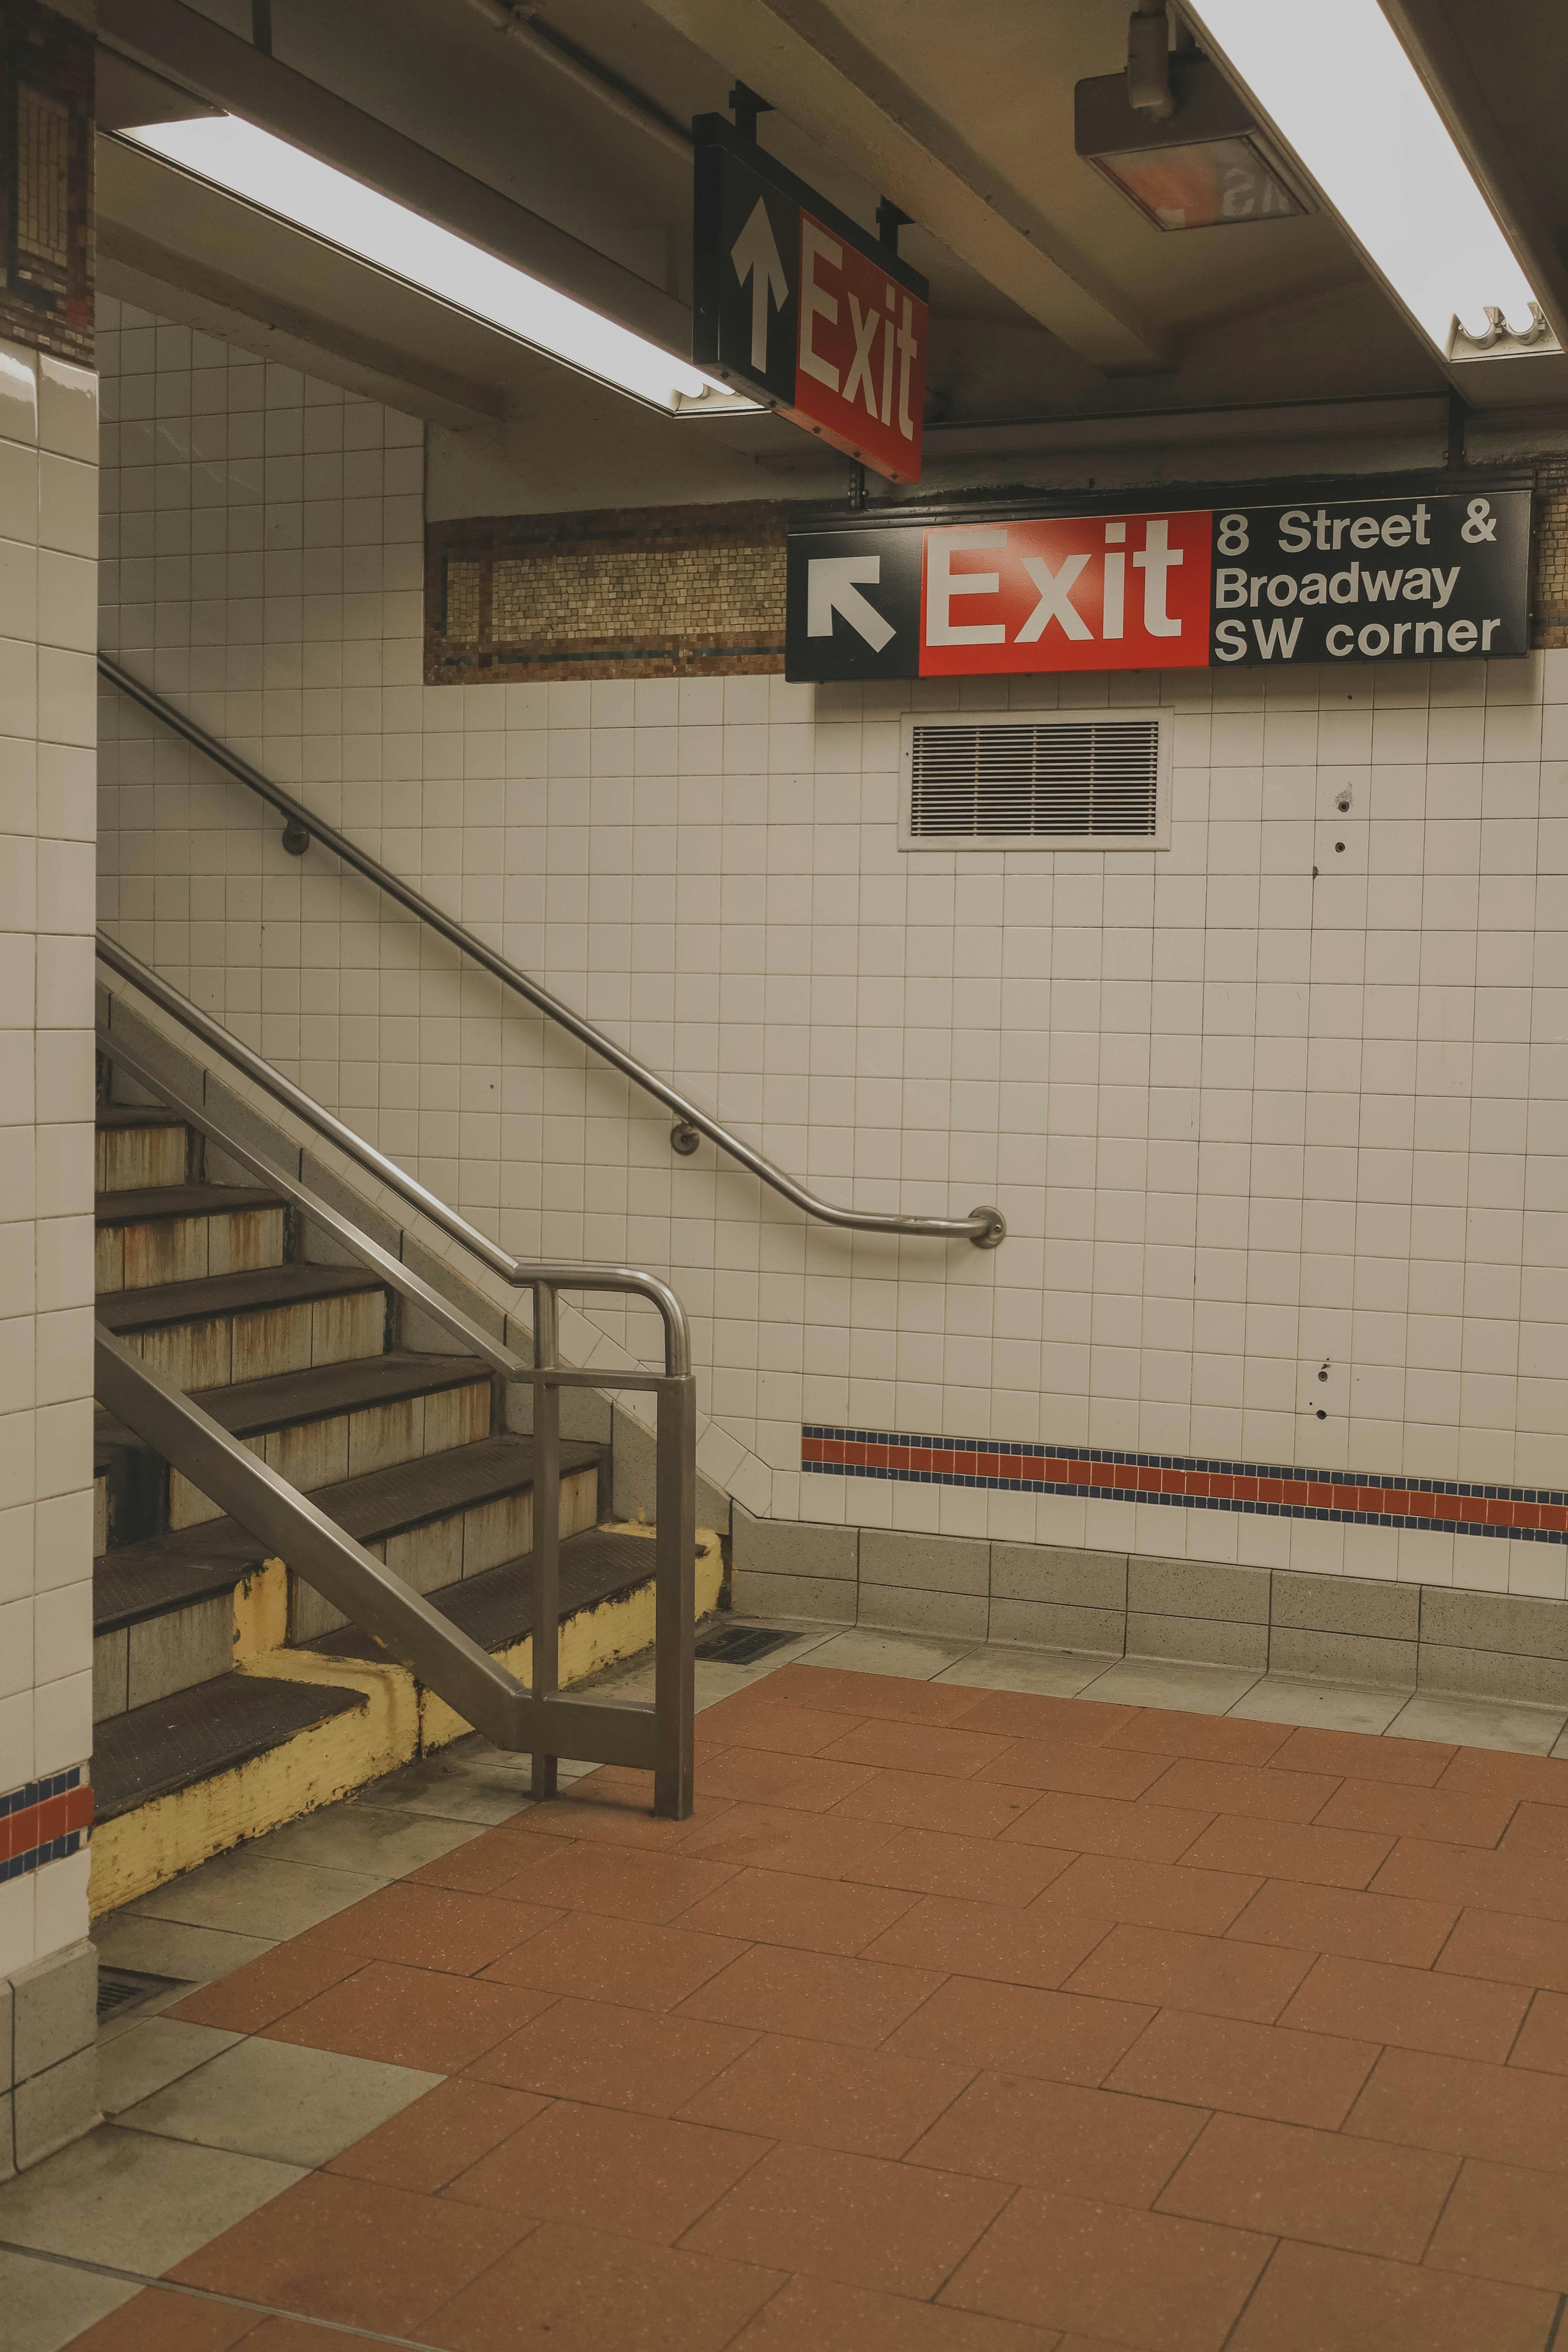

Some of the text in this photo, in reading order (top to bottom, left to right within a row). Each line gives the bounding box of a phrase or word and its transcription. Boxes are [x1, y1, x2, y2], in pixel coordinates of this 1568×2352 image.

[799, 217, 918, 441] Exit
[1217, 498, 1497, 556] 8 Street &
[926, 519, 1184, 646] Exit
[1215, 561, 1461, 609] Broadway
[1214, 617, 1501, 662] SW corner
